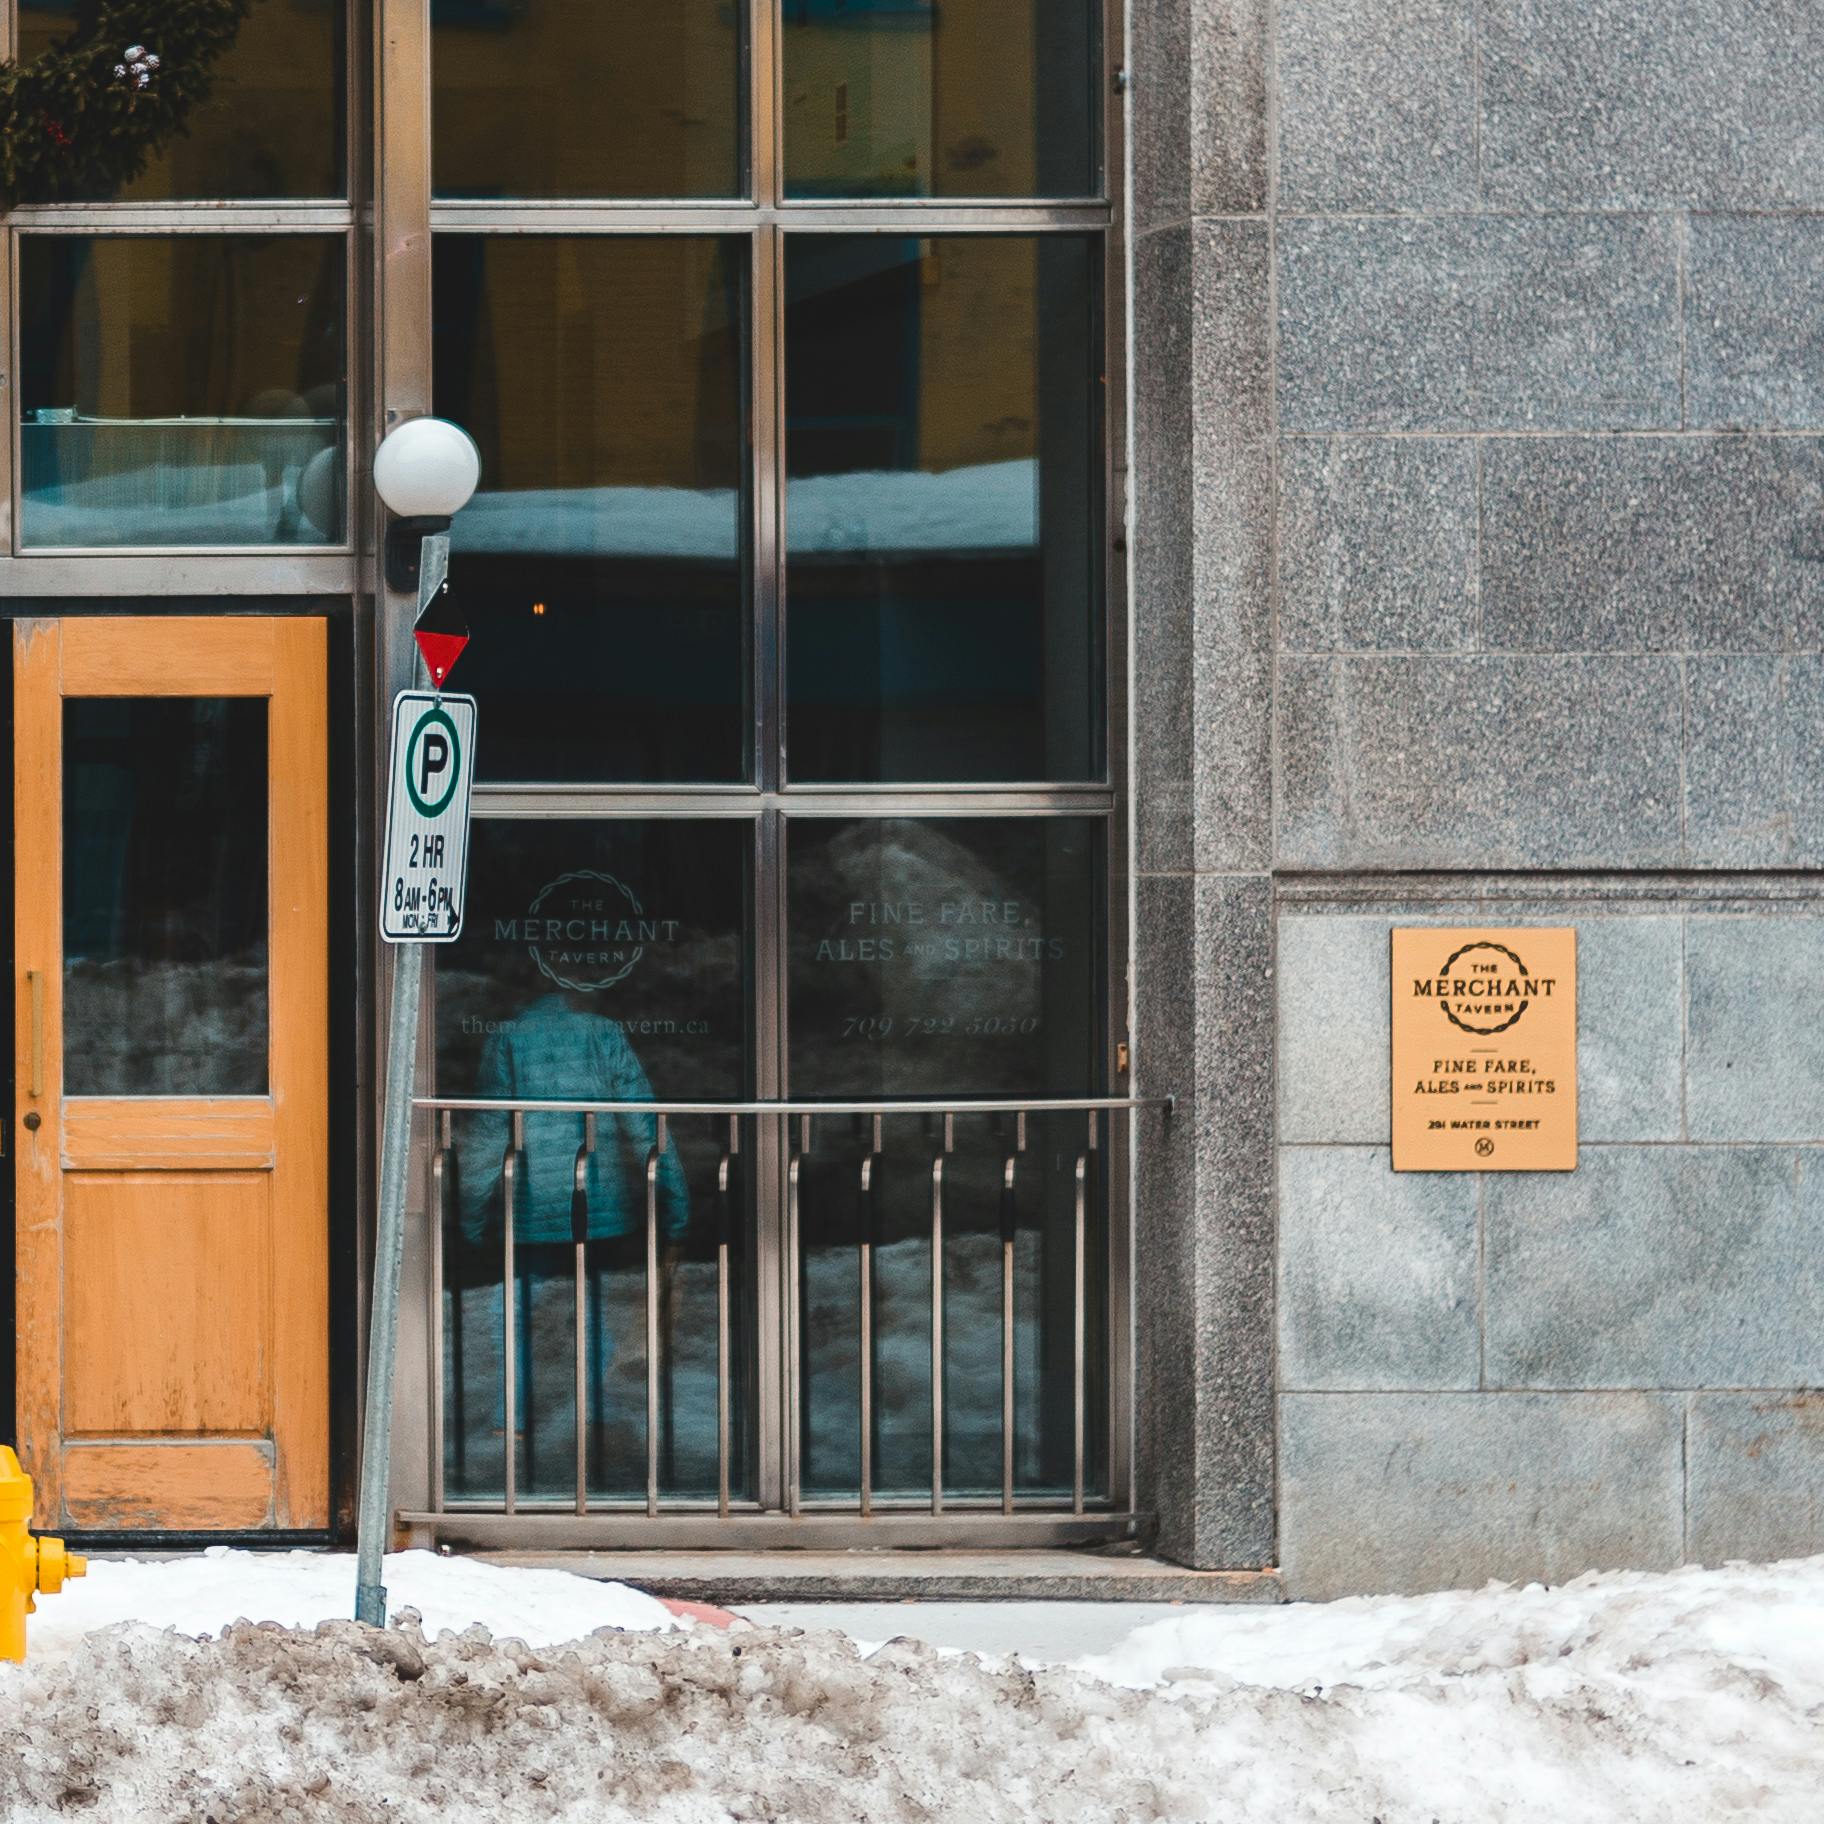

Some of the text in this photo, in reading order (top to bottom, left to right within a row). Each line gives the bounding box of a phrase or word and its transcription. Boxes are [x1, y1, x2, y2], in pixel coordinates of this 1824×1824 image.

[420, 733, 449, 795] P
[409, 834, 444, 868] 2 HR
[569, 900, 604, 911] THE
[849, 902, 924, 925] FINE
[494, 919, 680, 942] MERCHANT
[549, 950, 624, 964] TAVERN
[816, 939, 894, 961] ALES
[944, 938, 1065, 961] SPIRITS
[1471, 964, 1497, 973] THE
[1413, 979, 1556, 997] MERCHANT
[1455, 1003, 1514, 1014] TAVERN
[841, 1016, 894, 1040] 709
[904, 1016, 954, 1038] 722
[1433, 1060, 1536, 1075] FINE FARE,
[1414, 1080, 1460, 1094] ALES
[1486, 1080, 1556, 1094] SPIRITS
[1450, 1120, 1491, 1130] WATER
[1495, 1120, 1540, 1130] STREET
